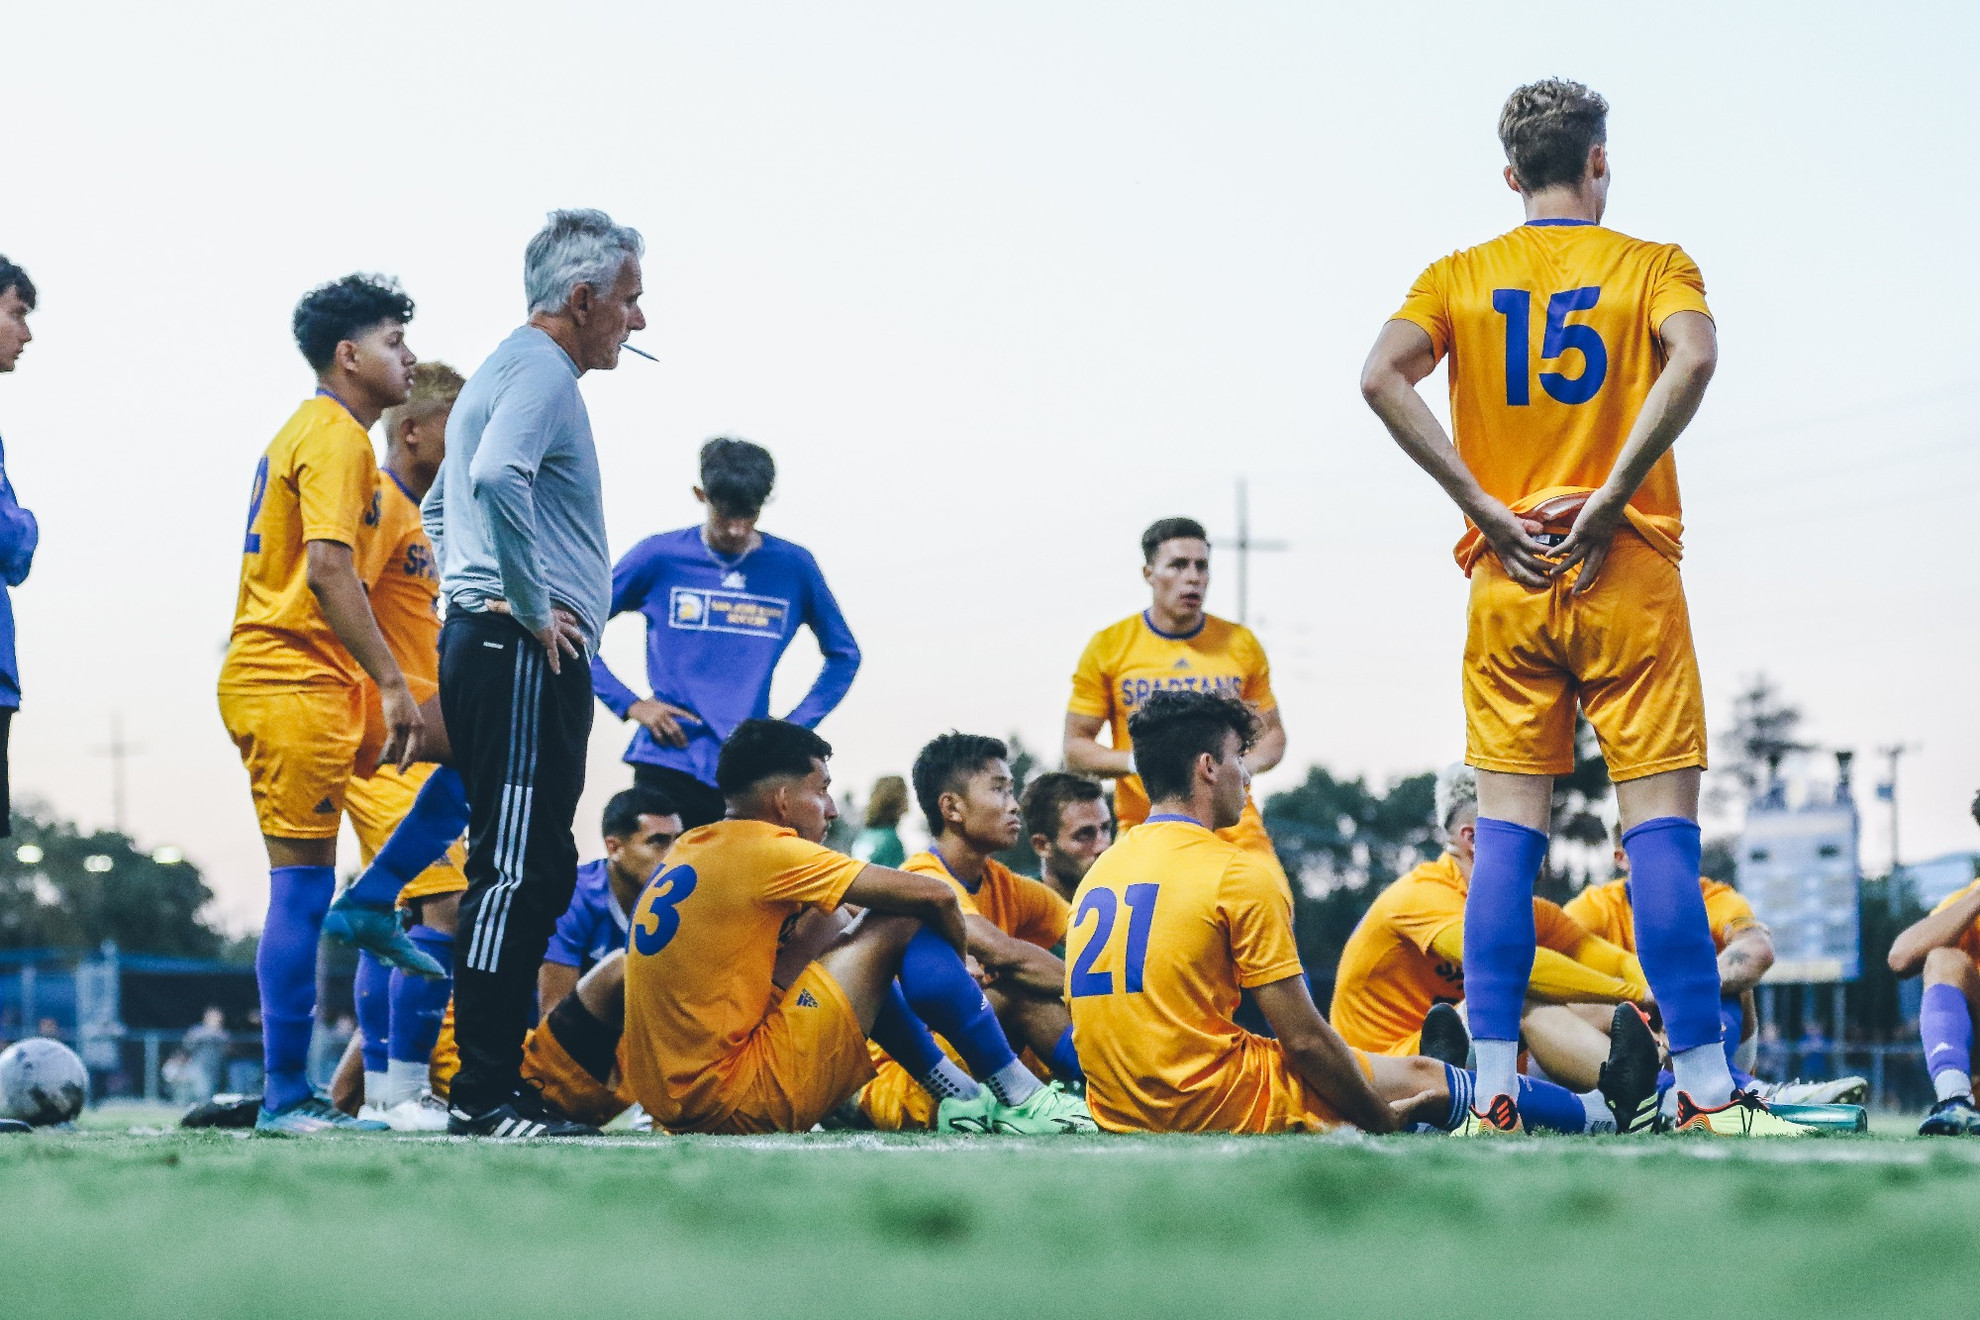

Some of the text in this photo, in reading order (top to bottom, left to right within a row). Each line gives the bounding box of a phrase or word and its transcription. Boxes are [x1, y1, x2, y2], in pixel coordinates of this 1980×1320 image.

[1493, 286, 1608, 406] 15
[624, 863, 698, 956] 3
[1071, 883, 1160, 998] 21
